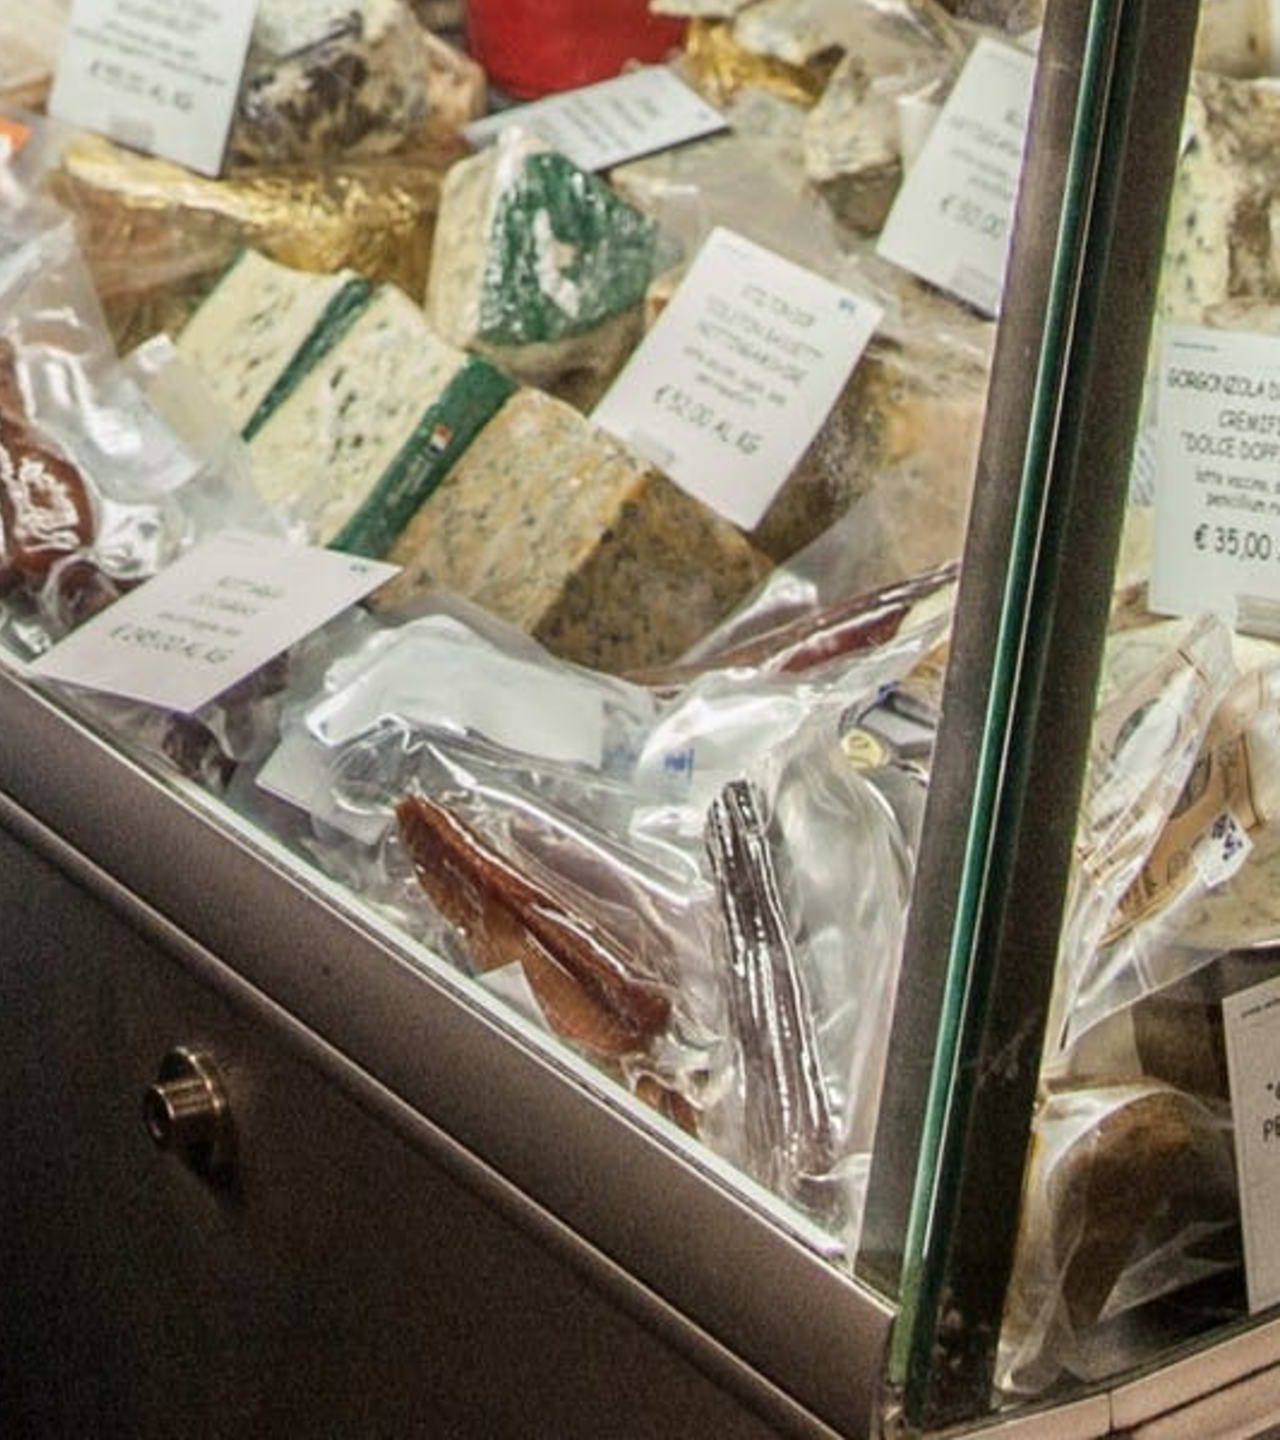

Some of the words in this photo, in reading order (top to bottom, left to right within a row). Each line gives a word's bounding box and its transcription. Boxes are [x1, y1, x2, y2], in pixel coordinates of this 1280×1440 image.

[1167, 366, 1265, 400] GORGONZOLA
[1194, 522, 1210, 551] €
[1214, 525, 1271, 562] 35,00
